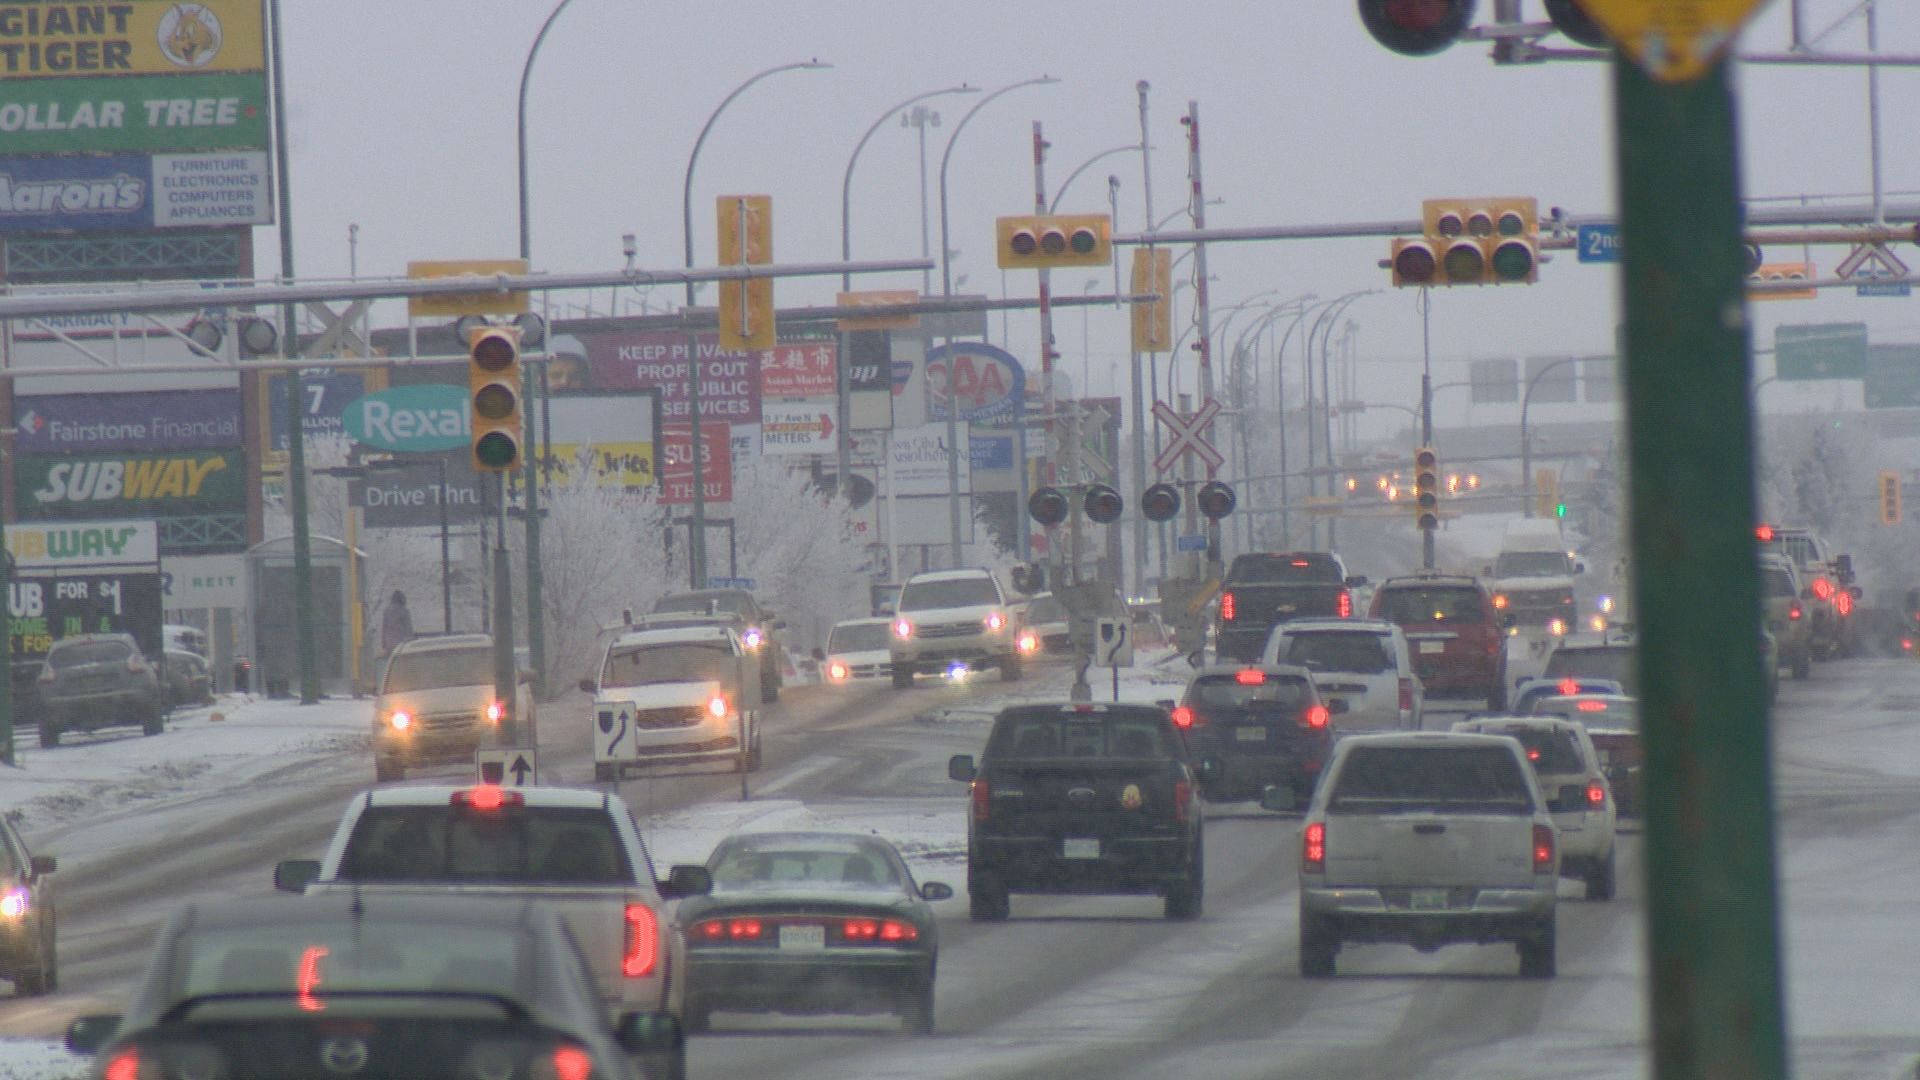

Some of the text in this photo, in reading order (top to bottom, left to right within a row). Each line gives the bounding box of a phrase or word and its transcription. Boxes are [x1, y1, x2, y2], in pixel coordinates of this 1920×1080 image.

[0, 6, 133, 36] GIANT
[0, 41, 132, 71] TIGER
[0, 98, 240, 132] OLLAR TREE
[172, 159, 248, 171] FURNITURE
[163, 174, 258, 188] ELECTRONICS
[169, 190, 254, 203] COMPUTERS
[170, 205, 255, 218] APPLIANCES
[619, 346, 666, 361] KEEP
[637, 362, 748, 380] PROFT OUT
[307, 385, 325, 414] 7
[51, 416, 238, 441] Fairstone Financial
[302, 416, 341, 428] ILLION
[765, 432, 812, 445] METERS
[664, 444, 711, 464] SUB
[34, 456, 226, 502] SUBWAY
[366, 484, 480, 506] Drive Thru
[671, 483, 721, 498] THRU
[4, 527, 138, 560] UBWAY
[56, 582, 88, 599] FOR
[192, 576, 236, 588] REIT
